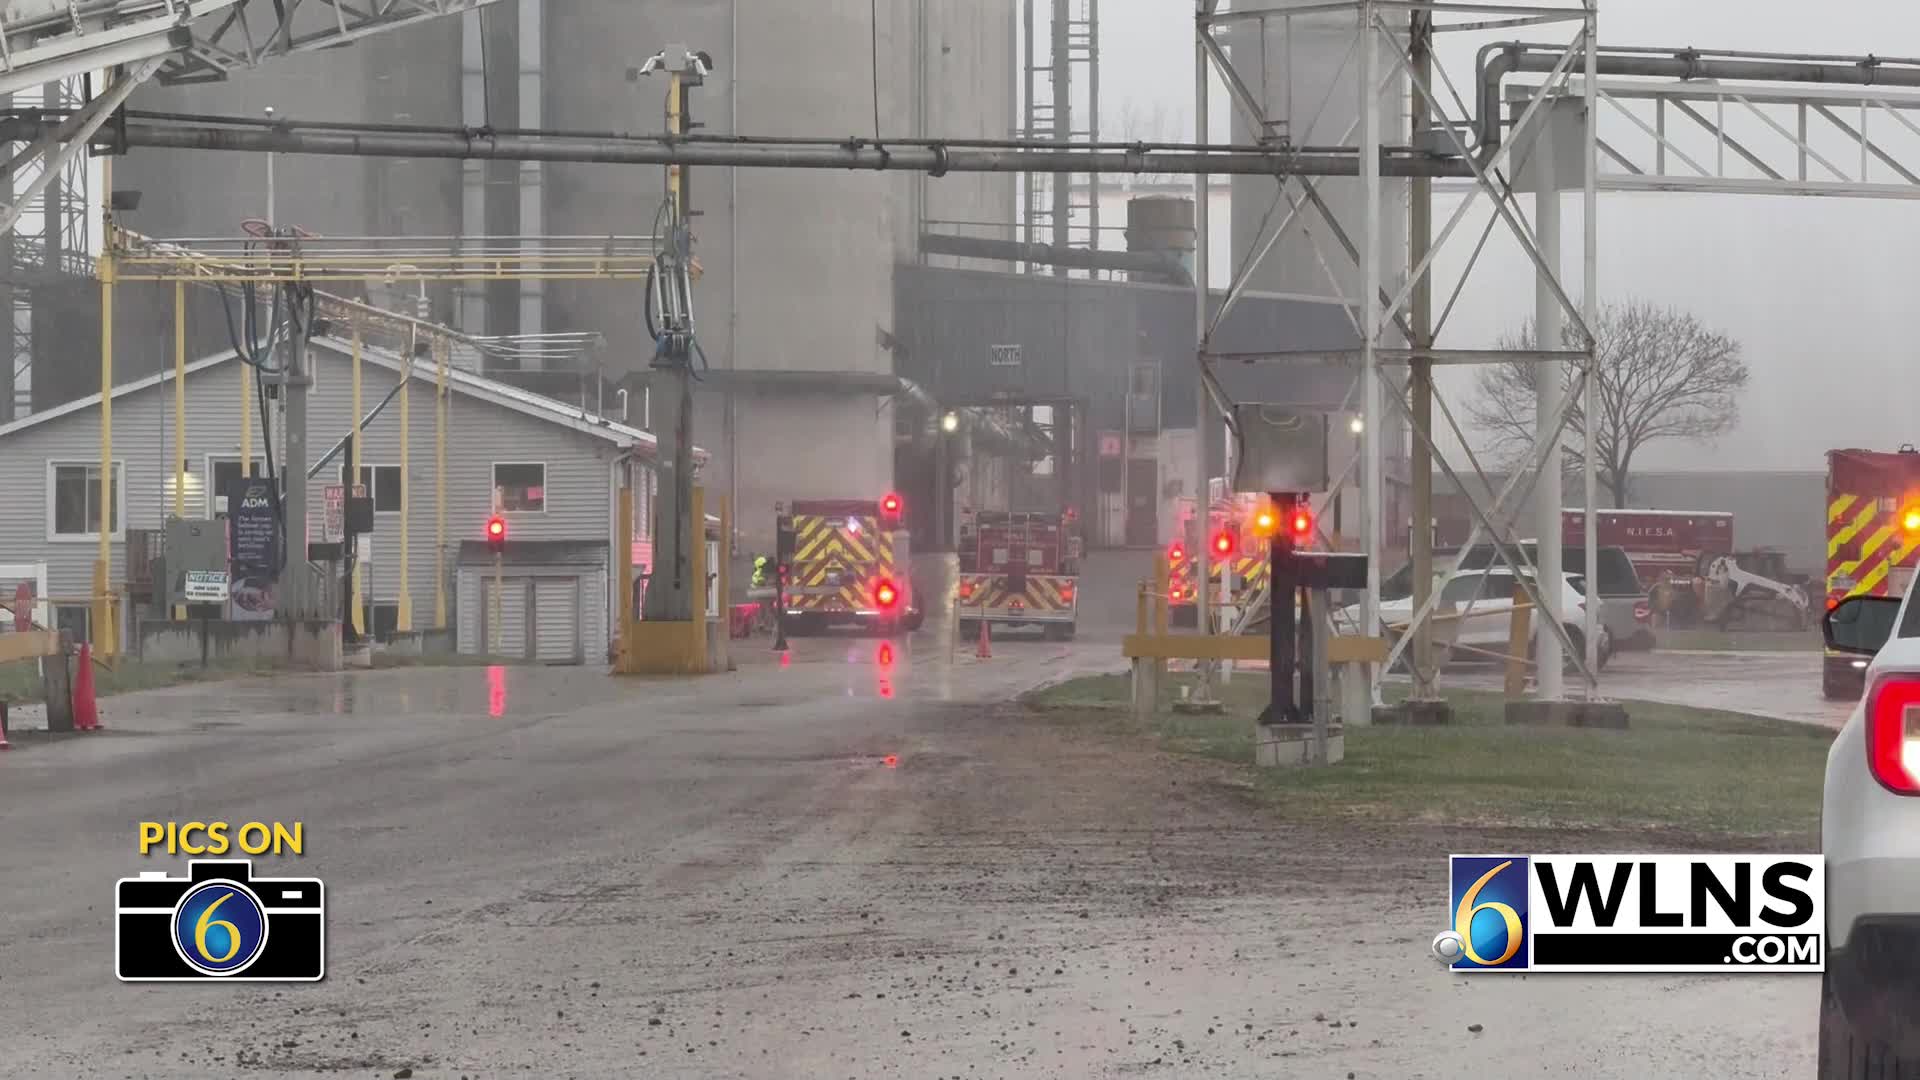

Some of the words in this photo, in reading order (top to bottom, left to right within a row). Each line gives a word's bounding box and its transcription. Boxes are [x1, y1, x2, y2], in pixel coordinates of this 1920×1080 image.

[991, 347, 1021, 363] NORTH
[241, 498, 269, 508] ADM
[189, 574, 224, 582] NOTICE
